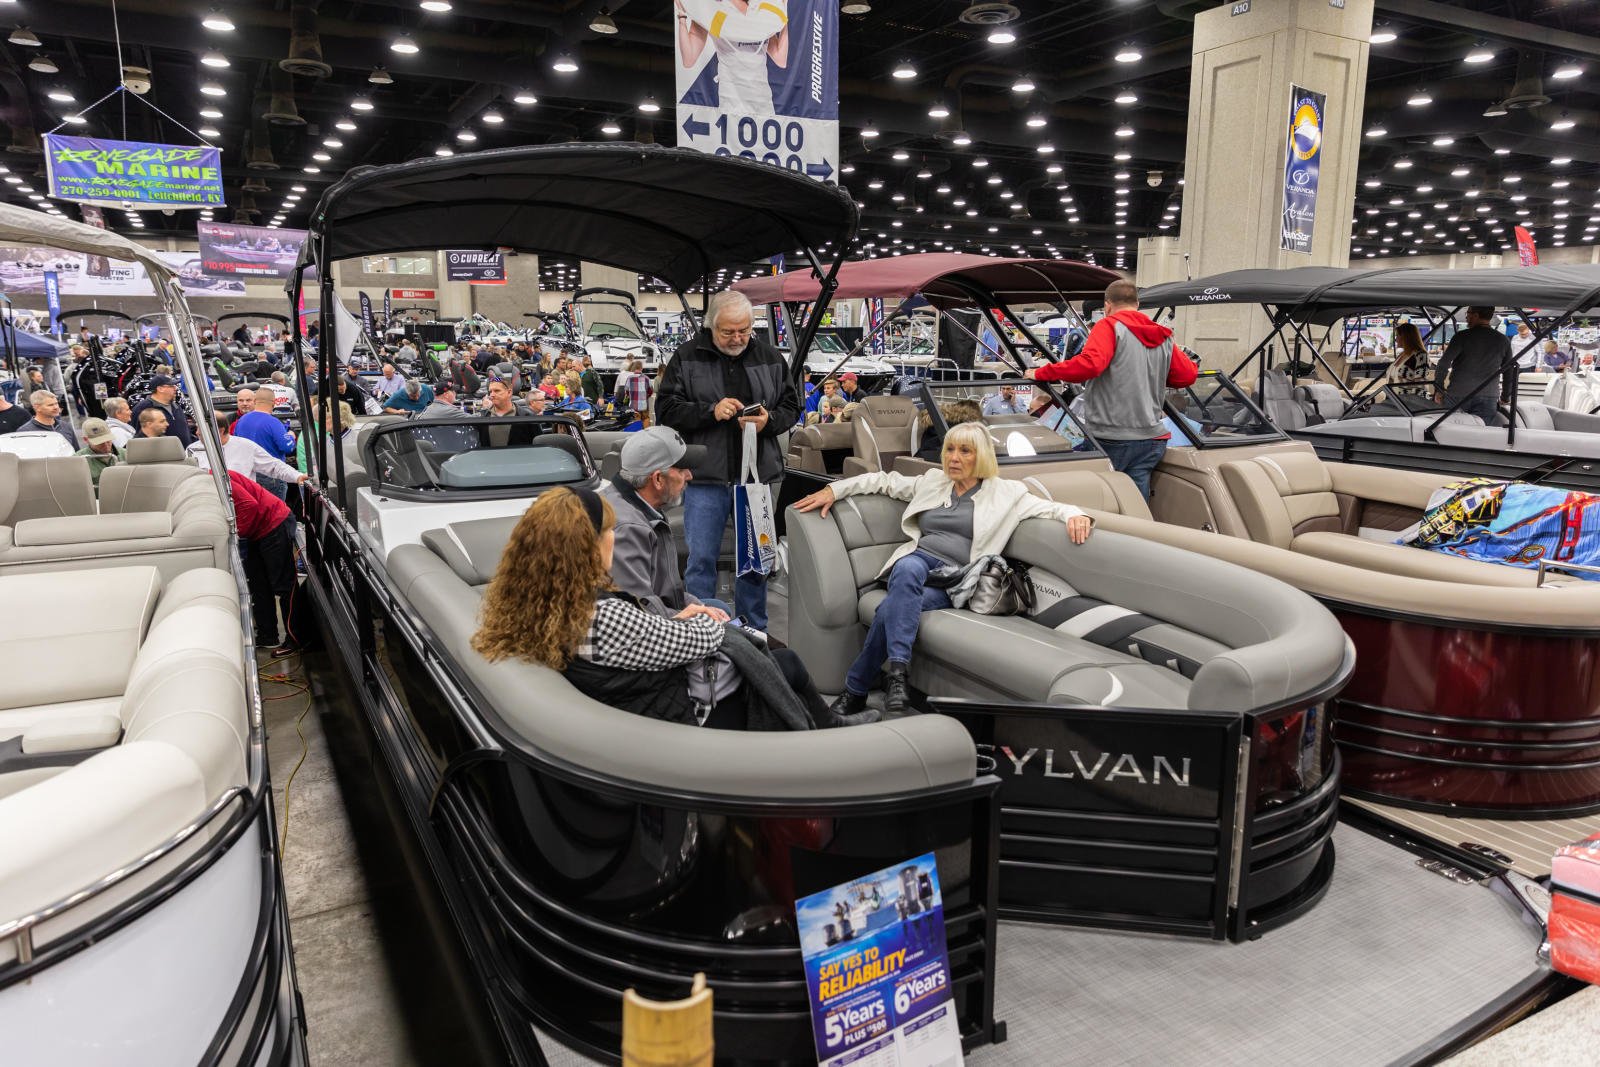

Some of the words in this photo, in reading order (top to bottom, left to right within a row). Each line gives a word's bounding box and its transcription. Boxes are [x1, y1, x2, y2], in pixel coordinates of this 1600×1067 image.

[1233, 3, 1249, 15] A10
[811, 11, 823, 104] PROGRESSIVE
[715, 114, 804, 152] 1000
[53, 148, 202, 164] RENEGADE
[95, 161, 219, 180] MARINE
[1286, 184, 1315, 195] VERANDA
[1283, 202, 1314, 219] Avalon
[460, 253, 500, 263] CURRENT
[362, 306, 372, 337] CURRENT
[1033, 583, 1062, 598] YLVAN
[976, 743, 1191, 787] SYLVAN
[819, 948, 907, 1002] RELIABILITY
[820, 961, 841, 980] SAY
[843, 953, 862, 971] YES
[864, 946, 879, 962] TO
[894, 983, 910, 1015] 6
[907, 969, 946, 999] Years
[825, 1014, 843, 1048] 5
[839, 999, 886, 1029] Years
[844, 1028, 867, 1046] PLUS
